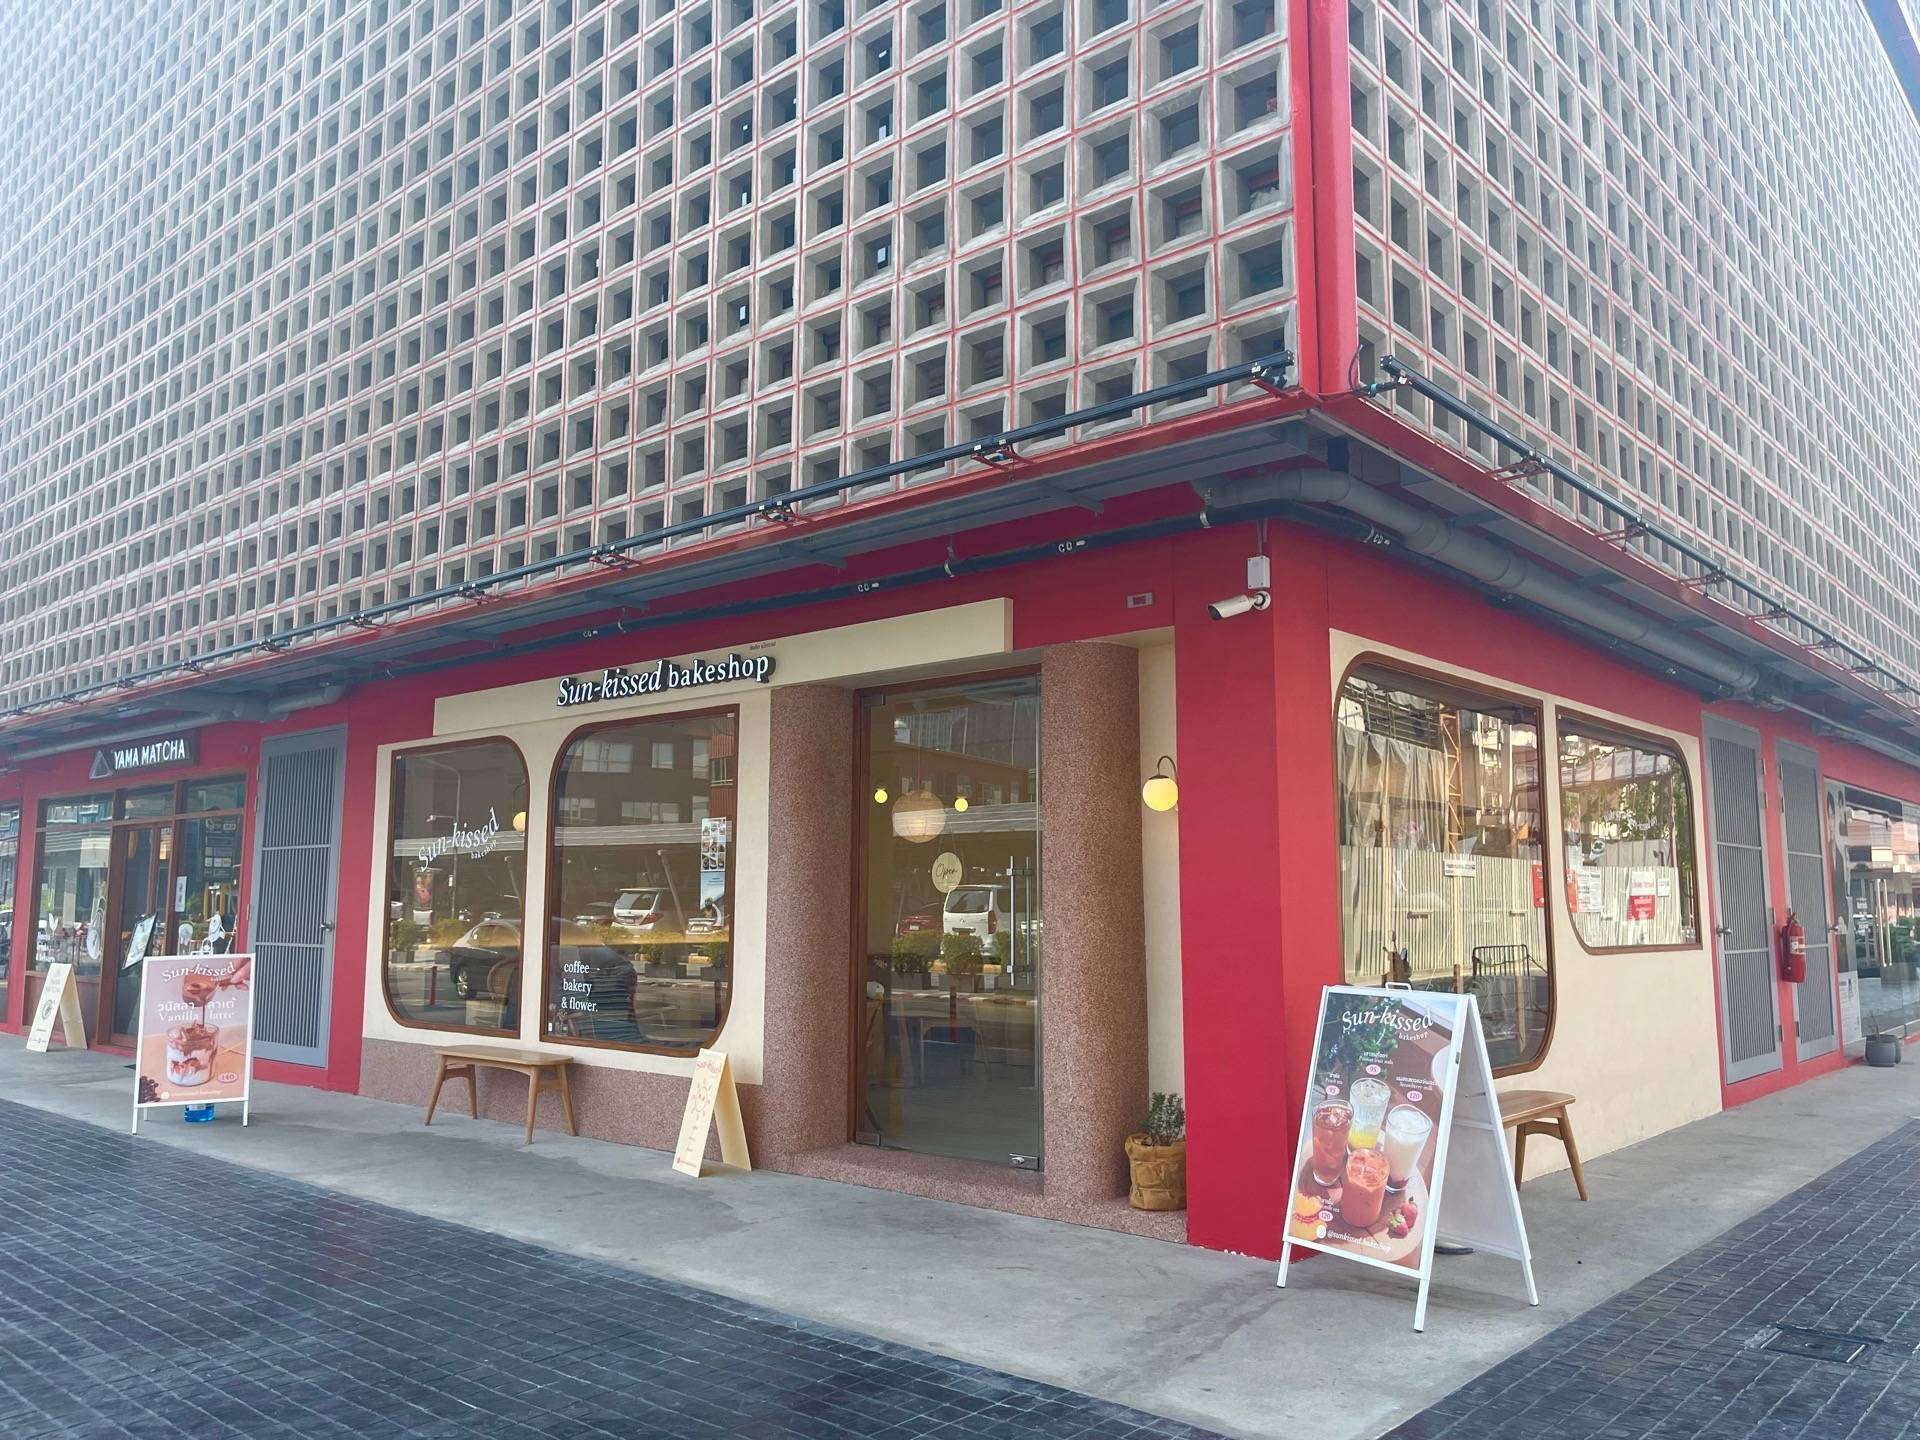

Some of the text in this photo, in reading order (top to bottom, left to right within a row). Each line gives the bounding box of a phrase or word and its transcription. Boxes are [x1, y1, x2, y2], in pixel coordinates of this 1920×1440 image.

[557, 653, 772, 706] Sun-kissed bakeshop
[114, 739, 186, 770] YAMA MATCHA
[418, 807, 500, 872] Sun-kissed
[161, 962, 236, 982] Sun-kissed
[563, 960, 590, 974] coffee
[563, 978, 593, 997] bakery
[561, 996, 599, 1012] & flower.
[159, 1010, 199, 1021] Vanilla
[1342, 1005, 1434, 1032] Sun-kissed
